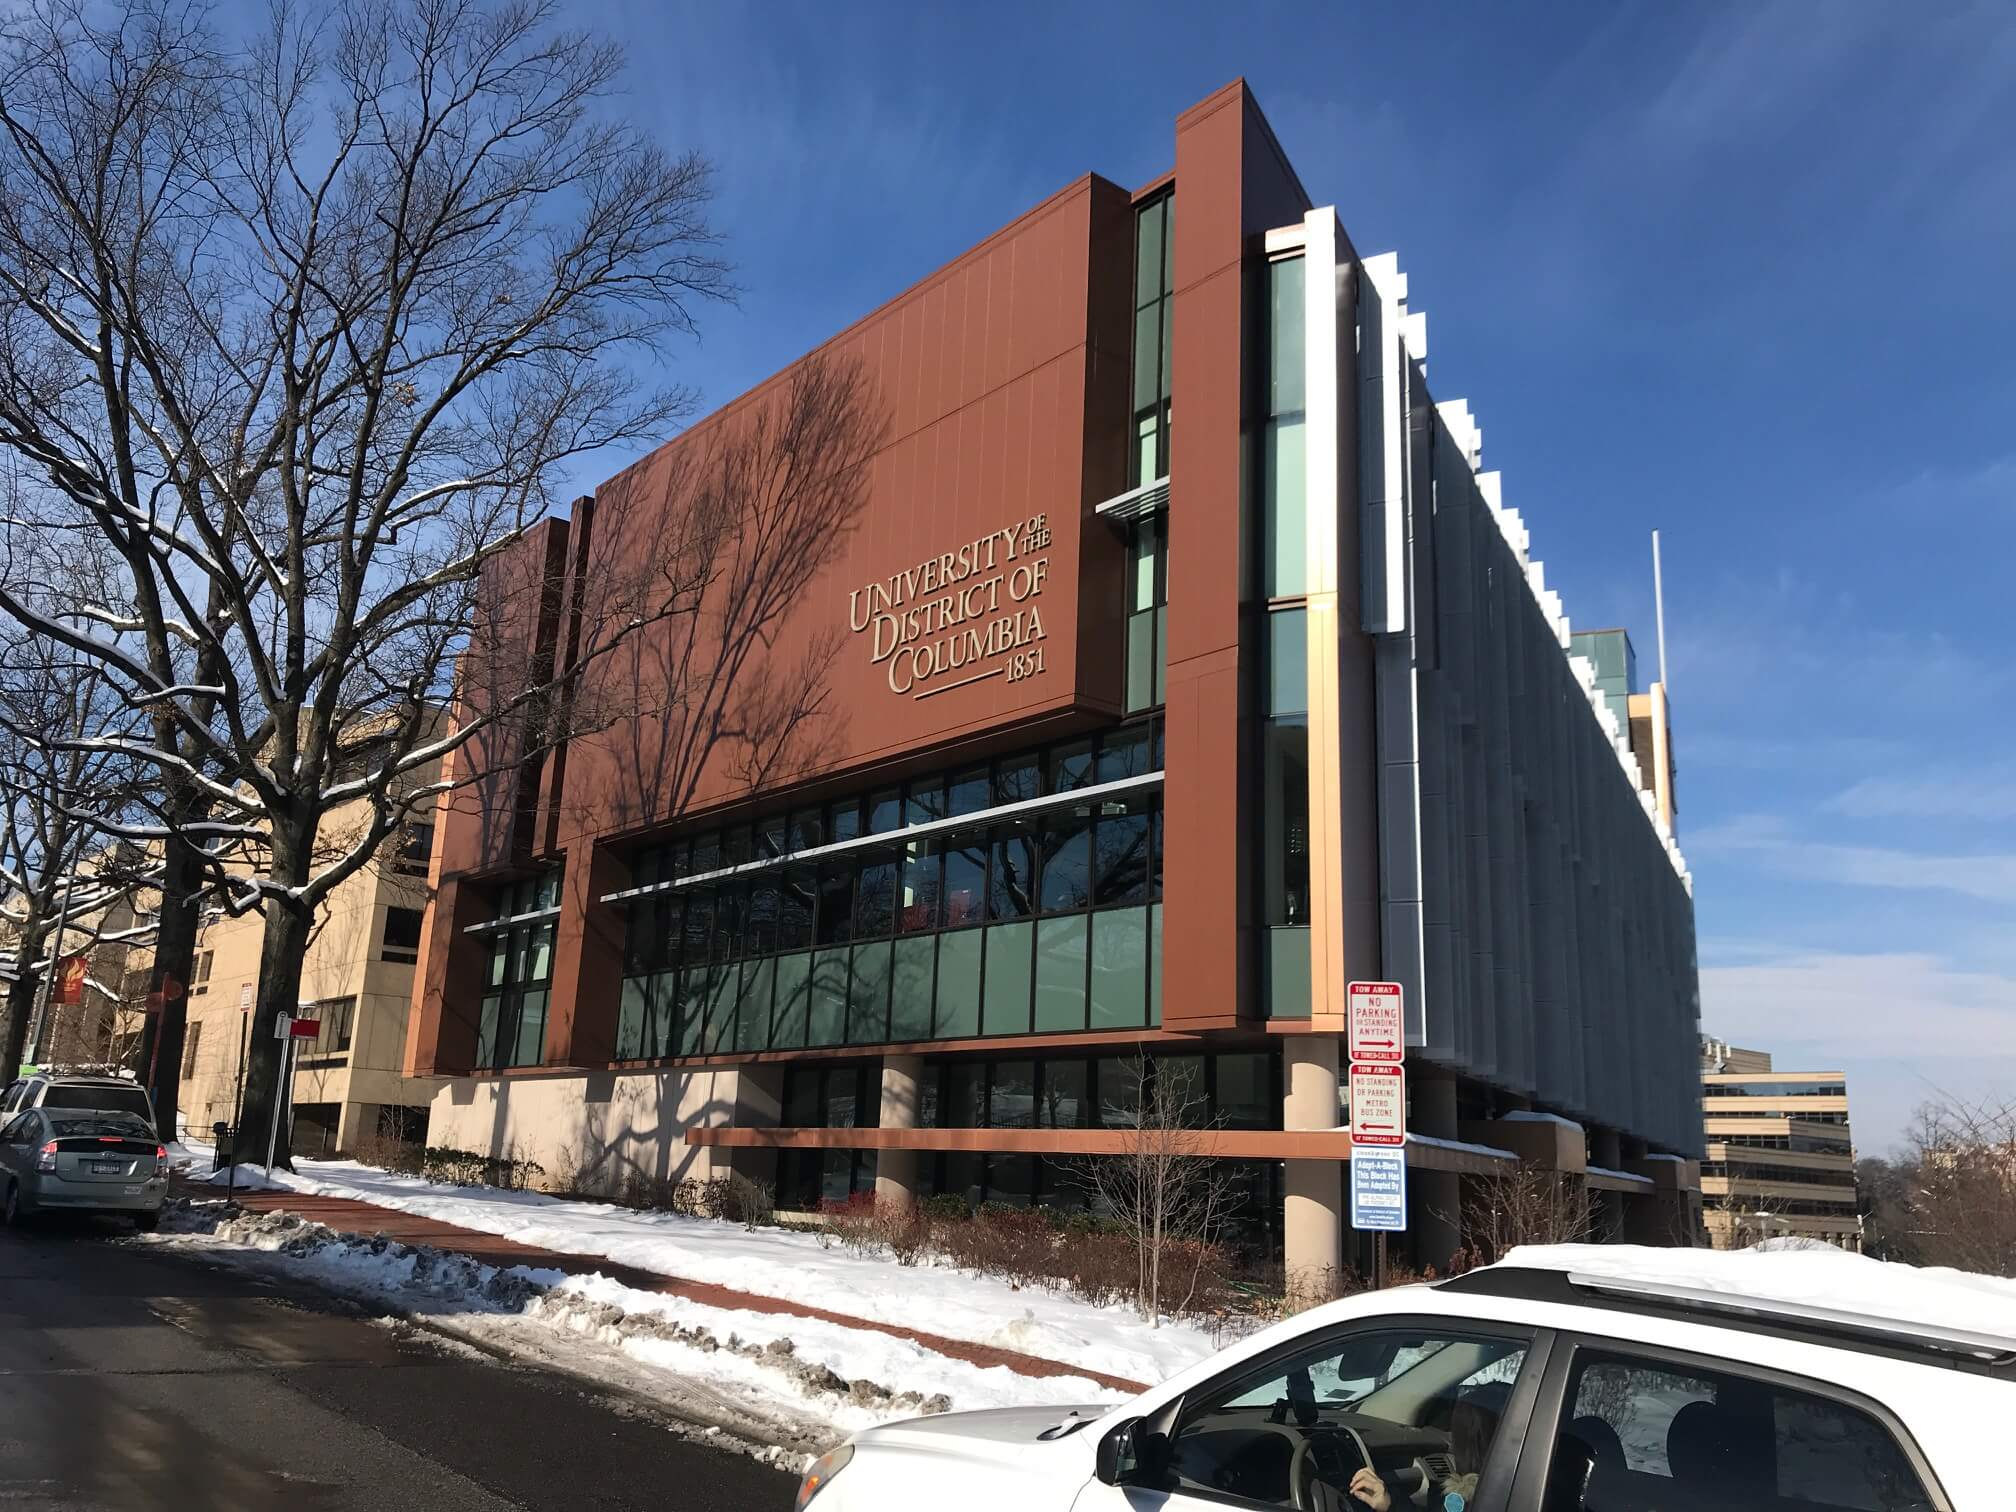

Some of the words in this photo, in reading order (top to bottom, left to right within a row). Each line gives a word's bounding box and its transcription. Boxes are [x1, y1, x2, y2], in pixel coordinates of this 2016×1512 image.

[1026, 513, 1047, 534] OF
[1021, 528, 1051, 554] THE
[849, 522, 1024, 632] UNIVERSITY
[870, 574, 1005, 663] DISTRICT
[1009, 558, 1049, 602] OF
[889, 606, 1047, 694] COLUMBIA
[1006, 647, 1046, 683] 1851
[1369, 998, 1382, 1006] NO
[1356, 1008, 1396, 1018] PARKING
[1363, 1019, 1397, 1027] STANDING
[1360, 1028, 1394, 1036] ANYTIME
[1368, 1089, 1395, 1097] PARKING
[1360, 1108, 1373, 1116] BUS
[1375, 1109, 1393, 1117] ZONE
[1357, 1171, 1369, 1179] This
[1370, 1171, 1386, 1180] Block
[1388, 1172, 1400, 1180] Has
[1370, 1182, 1391, 1191] Adopted
[1392, 1182, 1399, 1192] By
